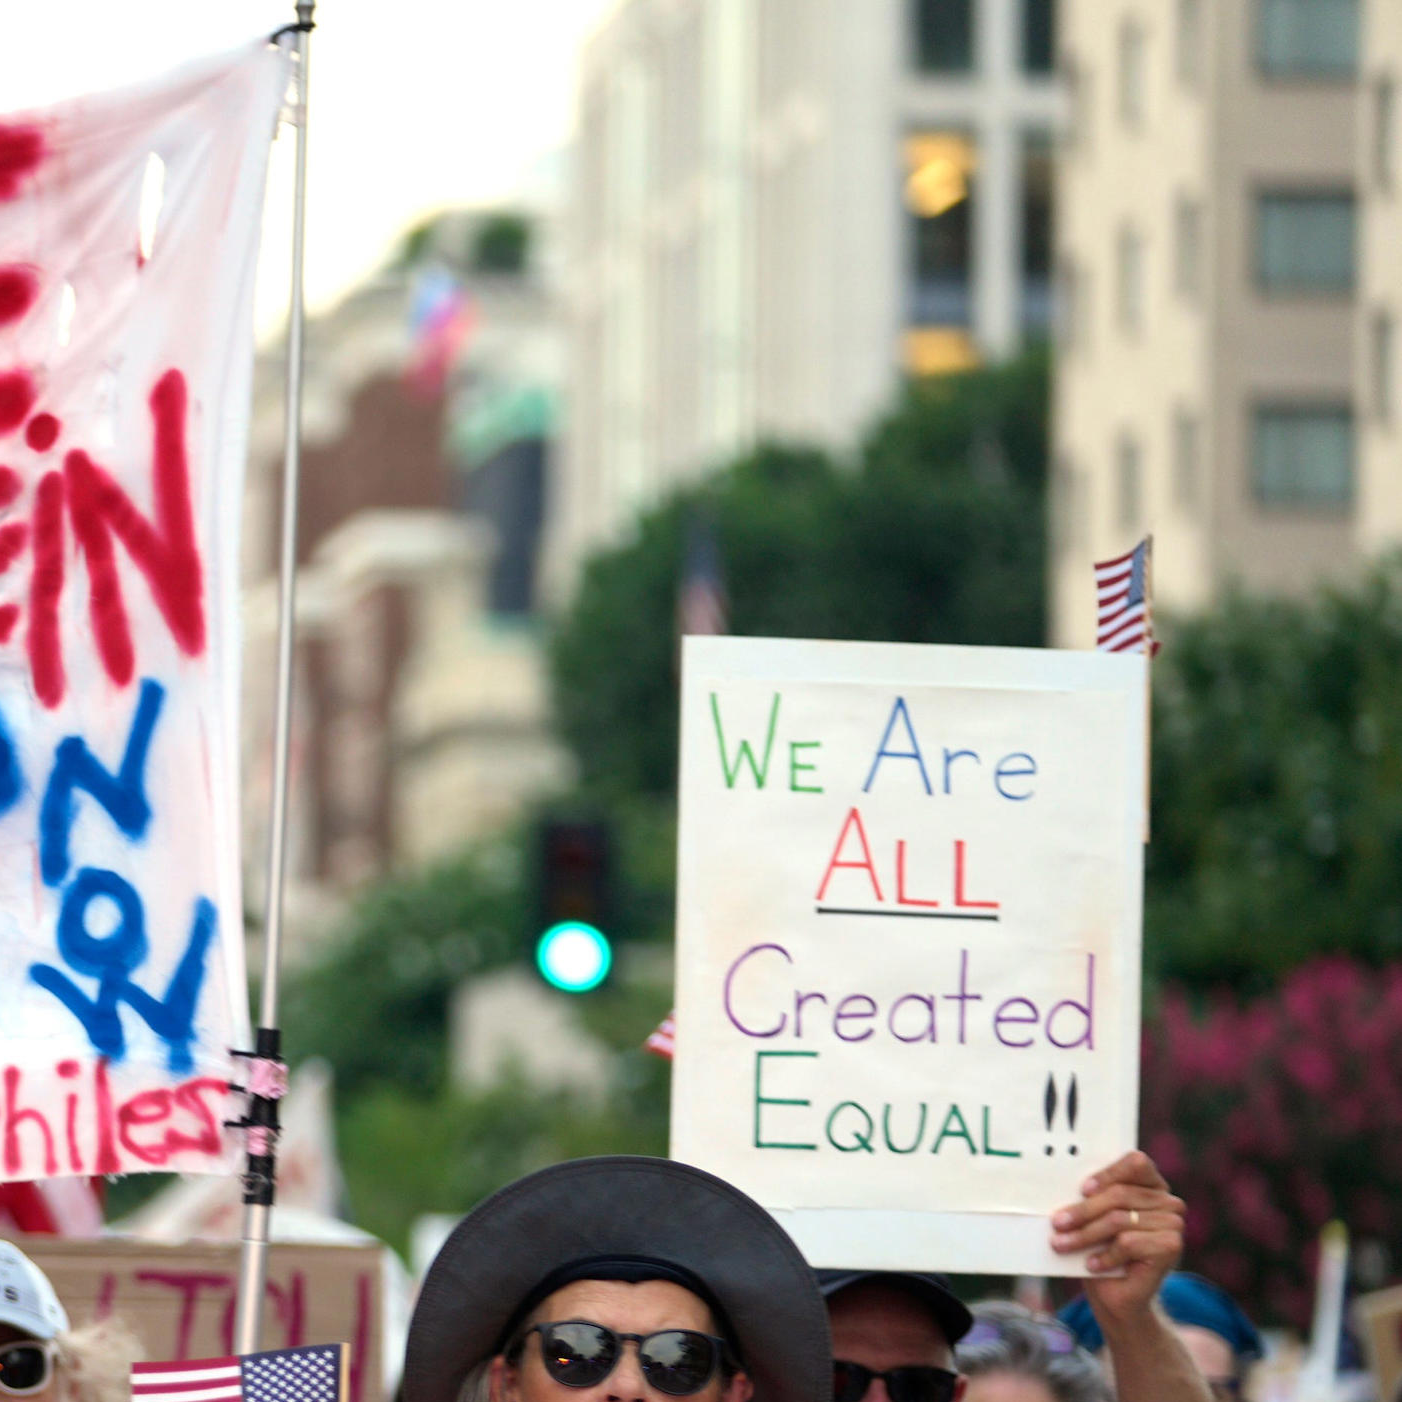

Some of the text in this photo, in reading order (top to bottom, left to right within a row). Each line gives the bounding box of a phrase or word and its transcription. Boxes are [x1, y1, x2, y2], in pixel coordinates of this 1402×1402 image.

[863, 696, 1040, 800] Are
[30, 677, 216, 1073] NOW
[815, 806, 1000, 910] ALL
[723, 943, 1096, 1051] Created
